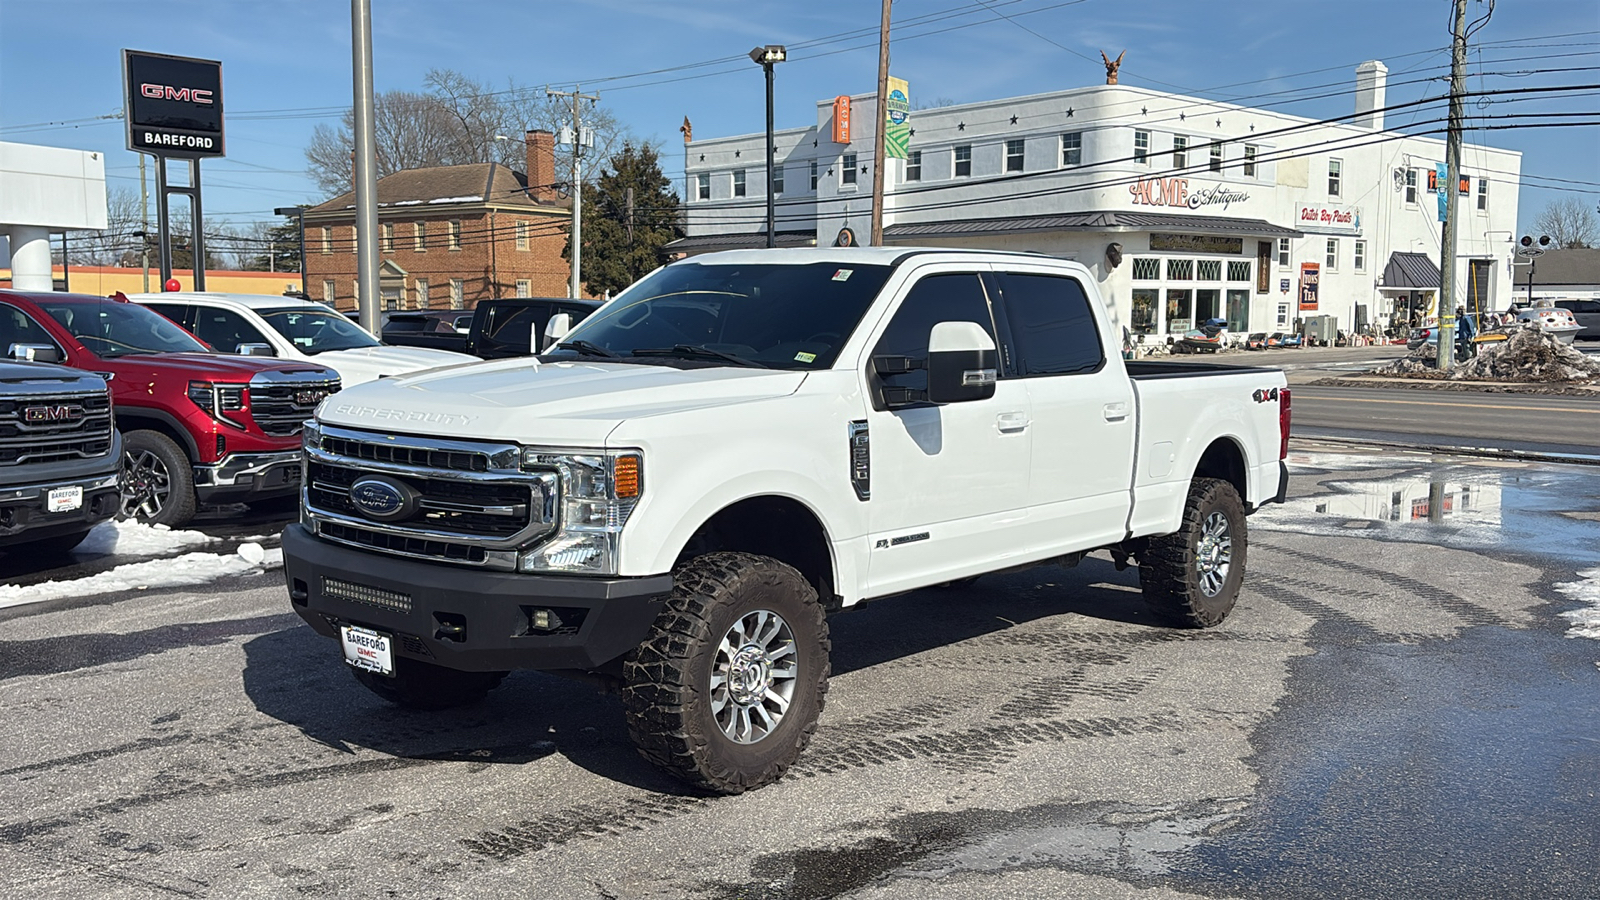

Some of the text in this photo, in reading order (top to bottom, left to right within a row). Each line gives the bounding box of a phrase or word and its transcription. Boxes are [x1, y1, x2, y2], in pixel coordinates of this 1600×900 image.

[141, 83, 213, 104] GMC
[840, 99, 848, 140] ACME
[144, 132, 213, 148] BAREFORD
[1129, 176, 1250, 211] ACME Antiques
[1301, 207, 1352, 225] Dutch Boy Paints
[1303, 289, 1316, 301] TEA
[297, 391, 328, 403] GM
[25, 404, 82, 422] GMC
[335, 404, 479, 426] SUPER DUTY
[360, 486, 390, 508] Ford
[346, 630, 386, 652] BAREFORD
[357, 647, 378, 659] GMC
